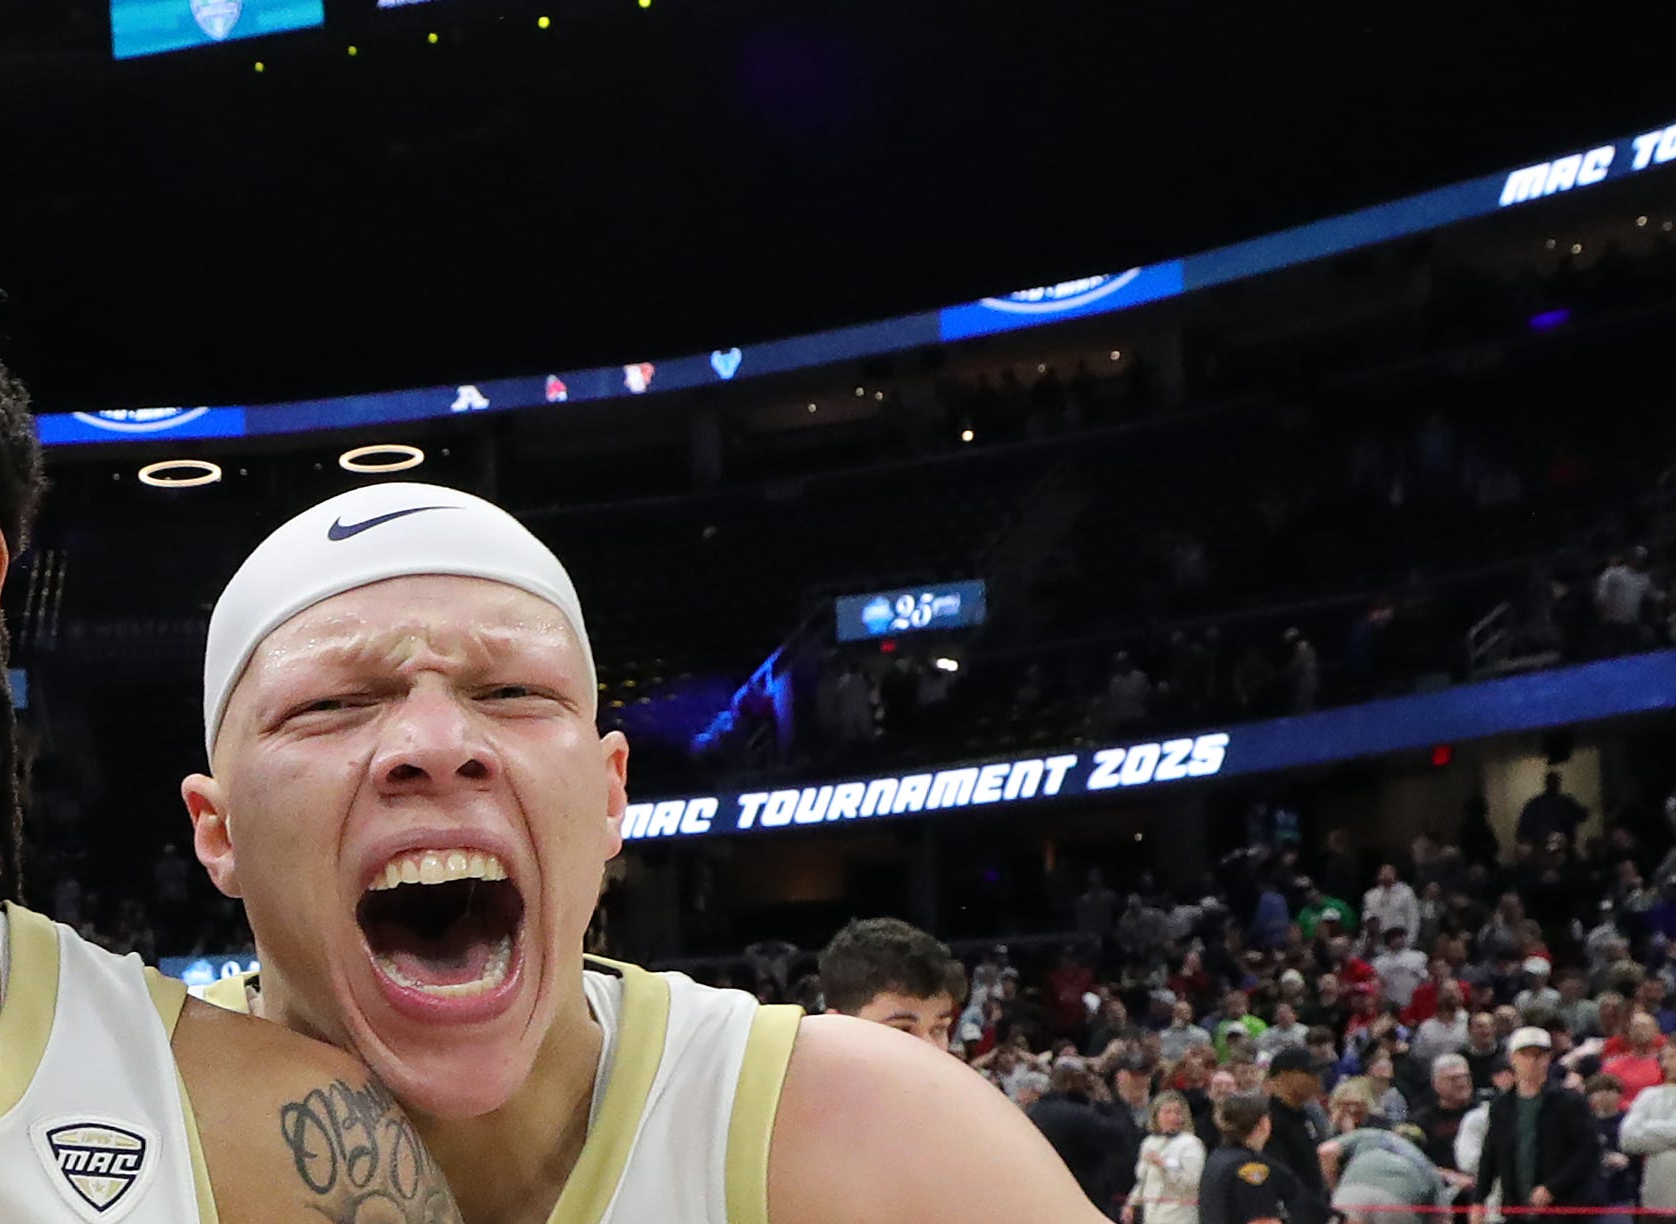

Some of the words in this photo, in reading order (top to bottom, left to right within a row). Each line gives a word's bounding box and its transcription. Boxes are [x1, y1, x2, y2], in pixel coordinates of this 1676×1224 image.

[1499, 145, 1615, 207] MAC
[621, 798, 719, 840] MAC
[736, 754, 1078, 830] TOURNAMENT
[1086, 733, 1229, 790] 2025
[56, 1148, 140, 1175] MAC
